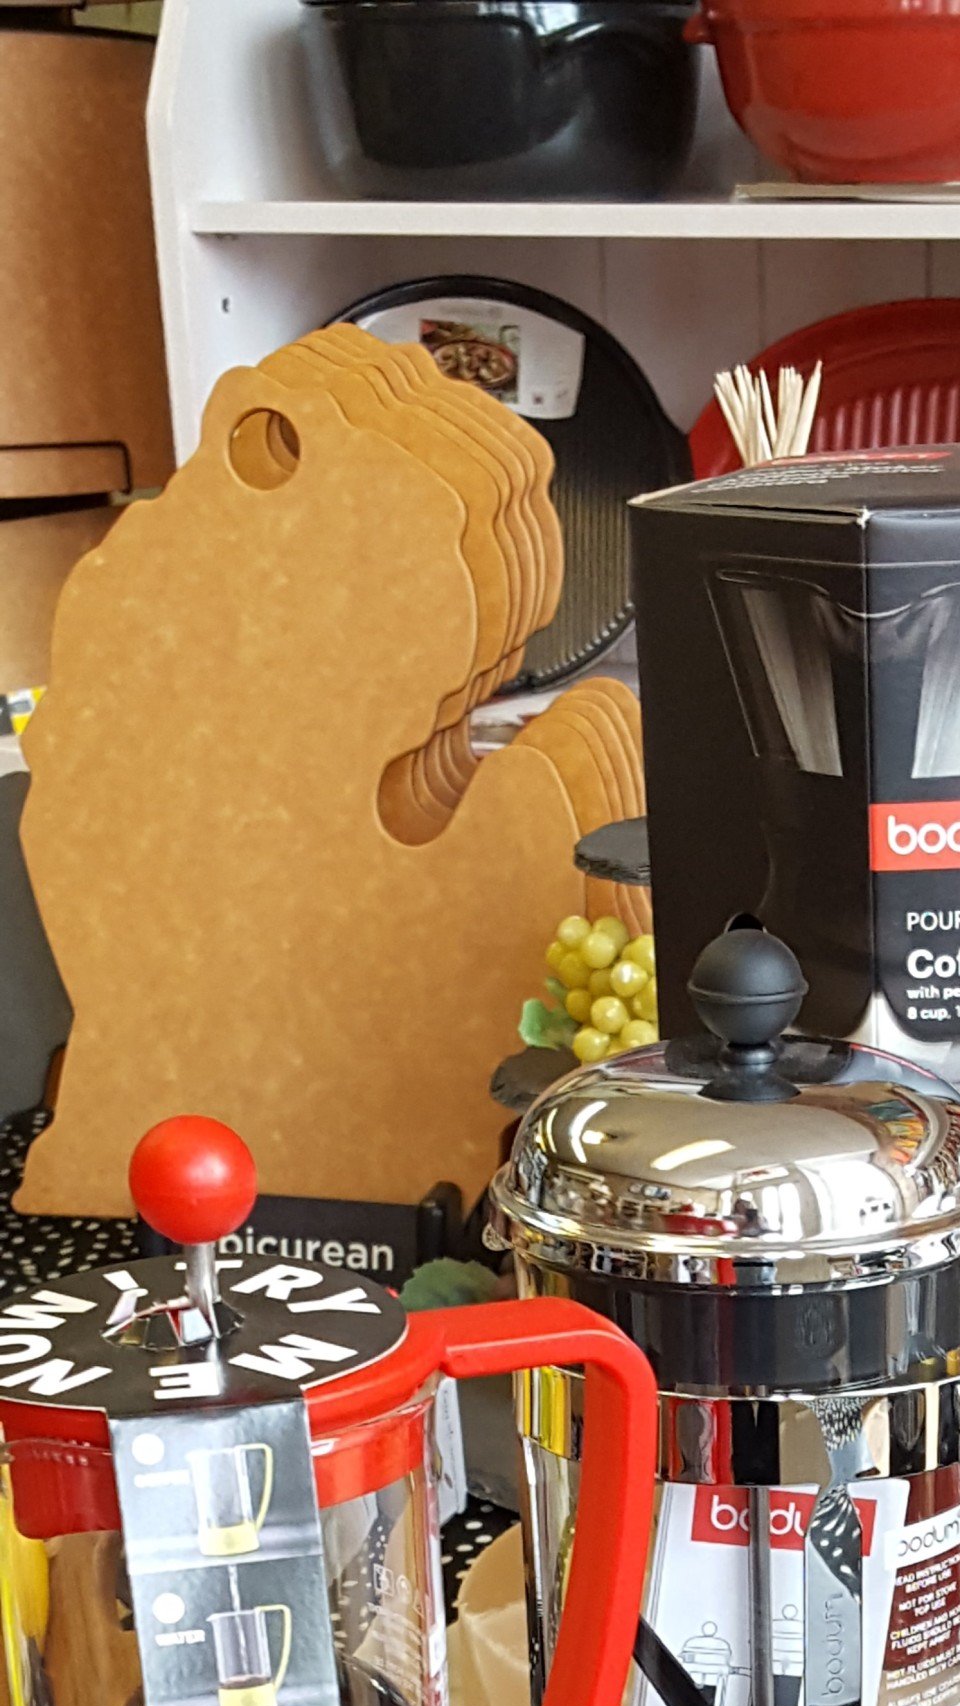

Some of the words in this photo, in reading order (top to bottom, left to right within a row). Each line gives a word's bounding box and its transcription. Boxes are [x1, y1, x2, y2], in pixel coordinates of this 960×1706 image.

[906, 984, 940, 1000] with
[907, 1006, 917, 1020] 8
[218, 1228, 394, 1272] picurean
